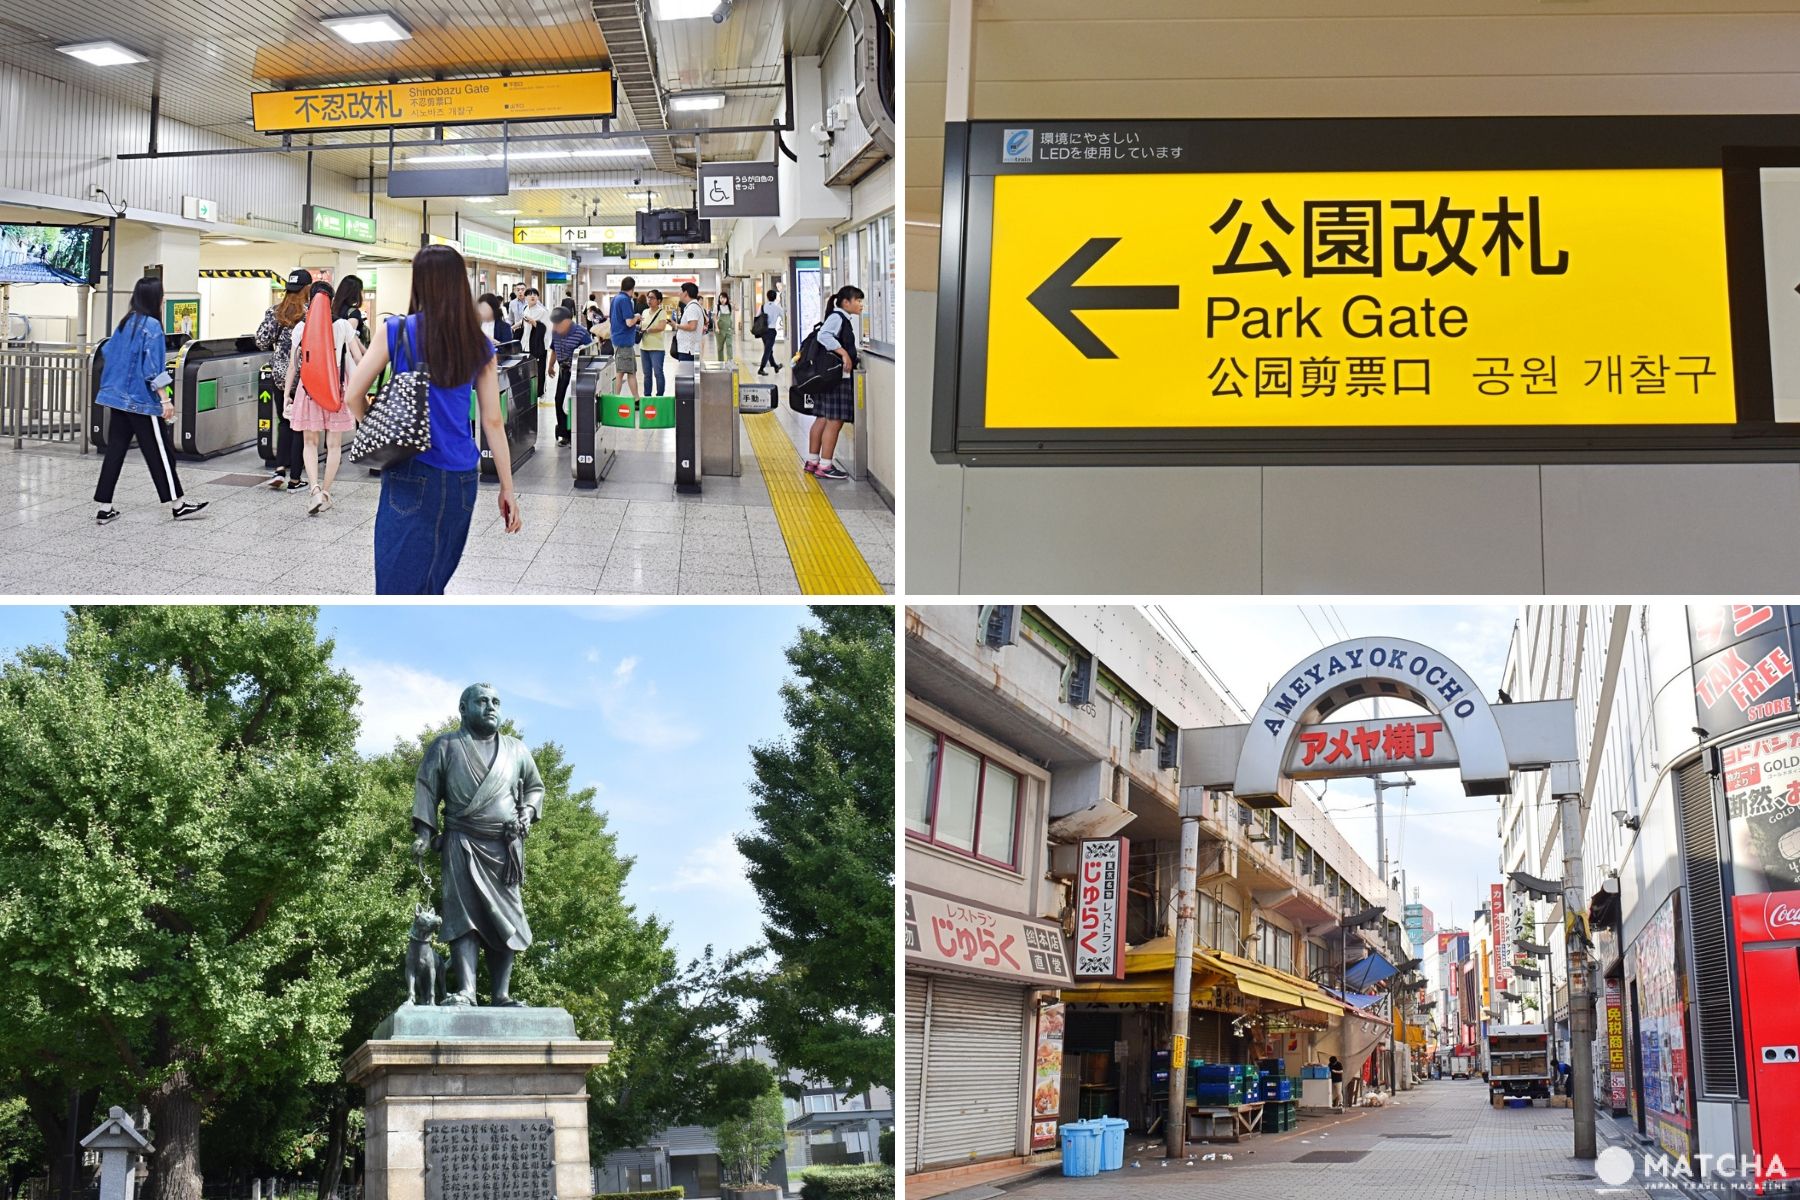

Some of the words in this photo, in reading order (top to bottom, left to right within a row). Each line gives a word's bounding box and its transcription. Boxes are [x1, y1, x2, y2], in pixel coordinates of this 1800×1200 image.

[294, 90, 402, 123] 不忍改札
[409, 86, 461, 98] Shinobazu
[464, 84, 489, 94] Gate
[1040, 132, 1139, 145] 環境にやさしい
[1040, 147, 1183, 160] LEDを使用しています
[1208, 195, 1569, 279] 公園改札
[1205, 296, 1322, 340] Park
[1342, 296, 1469, 340] Gate
[1207, 355, 1433, 400] 公园剪票口
[1471, 355, 1559, 397] 공원
[1583, 353, 1718, 397] 개찰구
[1263, 648, 1475, 736] AMEYAYOKOCHO
[1696, 647, 1750, 709] TAX
[1729, 646, 1793, 711] FREE
[1748, 697, 1791, 721] STORE
[1300, 722, 1443, 766] アメヤ横丁
[1764, 756, 1799, 772] GOLD
[1769, 806, 1795, 824] GOLD
[947, 904, 996, 928] レストラン
[1080, 861, 1101, 954] じゅらく
[1102, 902, 1112, 953] レストラン
[932, 916, 1021, 971] じゅらく
[1608, 1007, 1624, 1062] 免税商店
